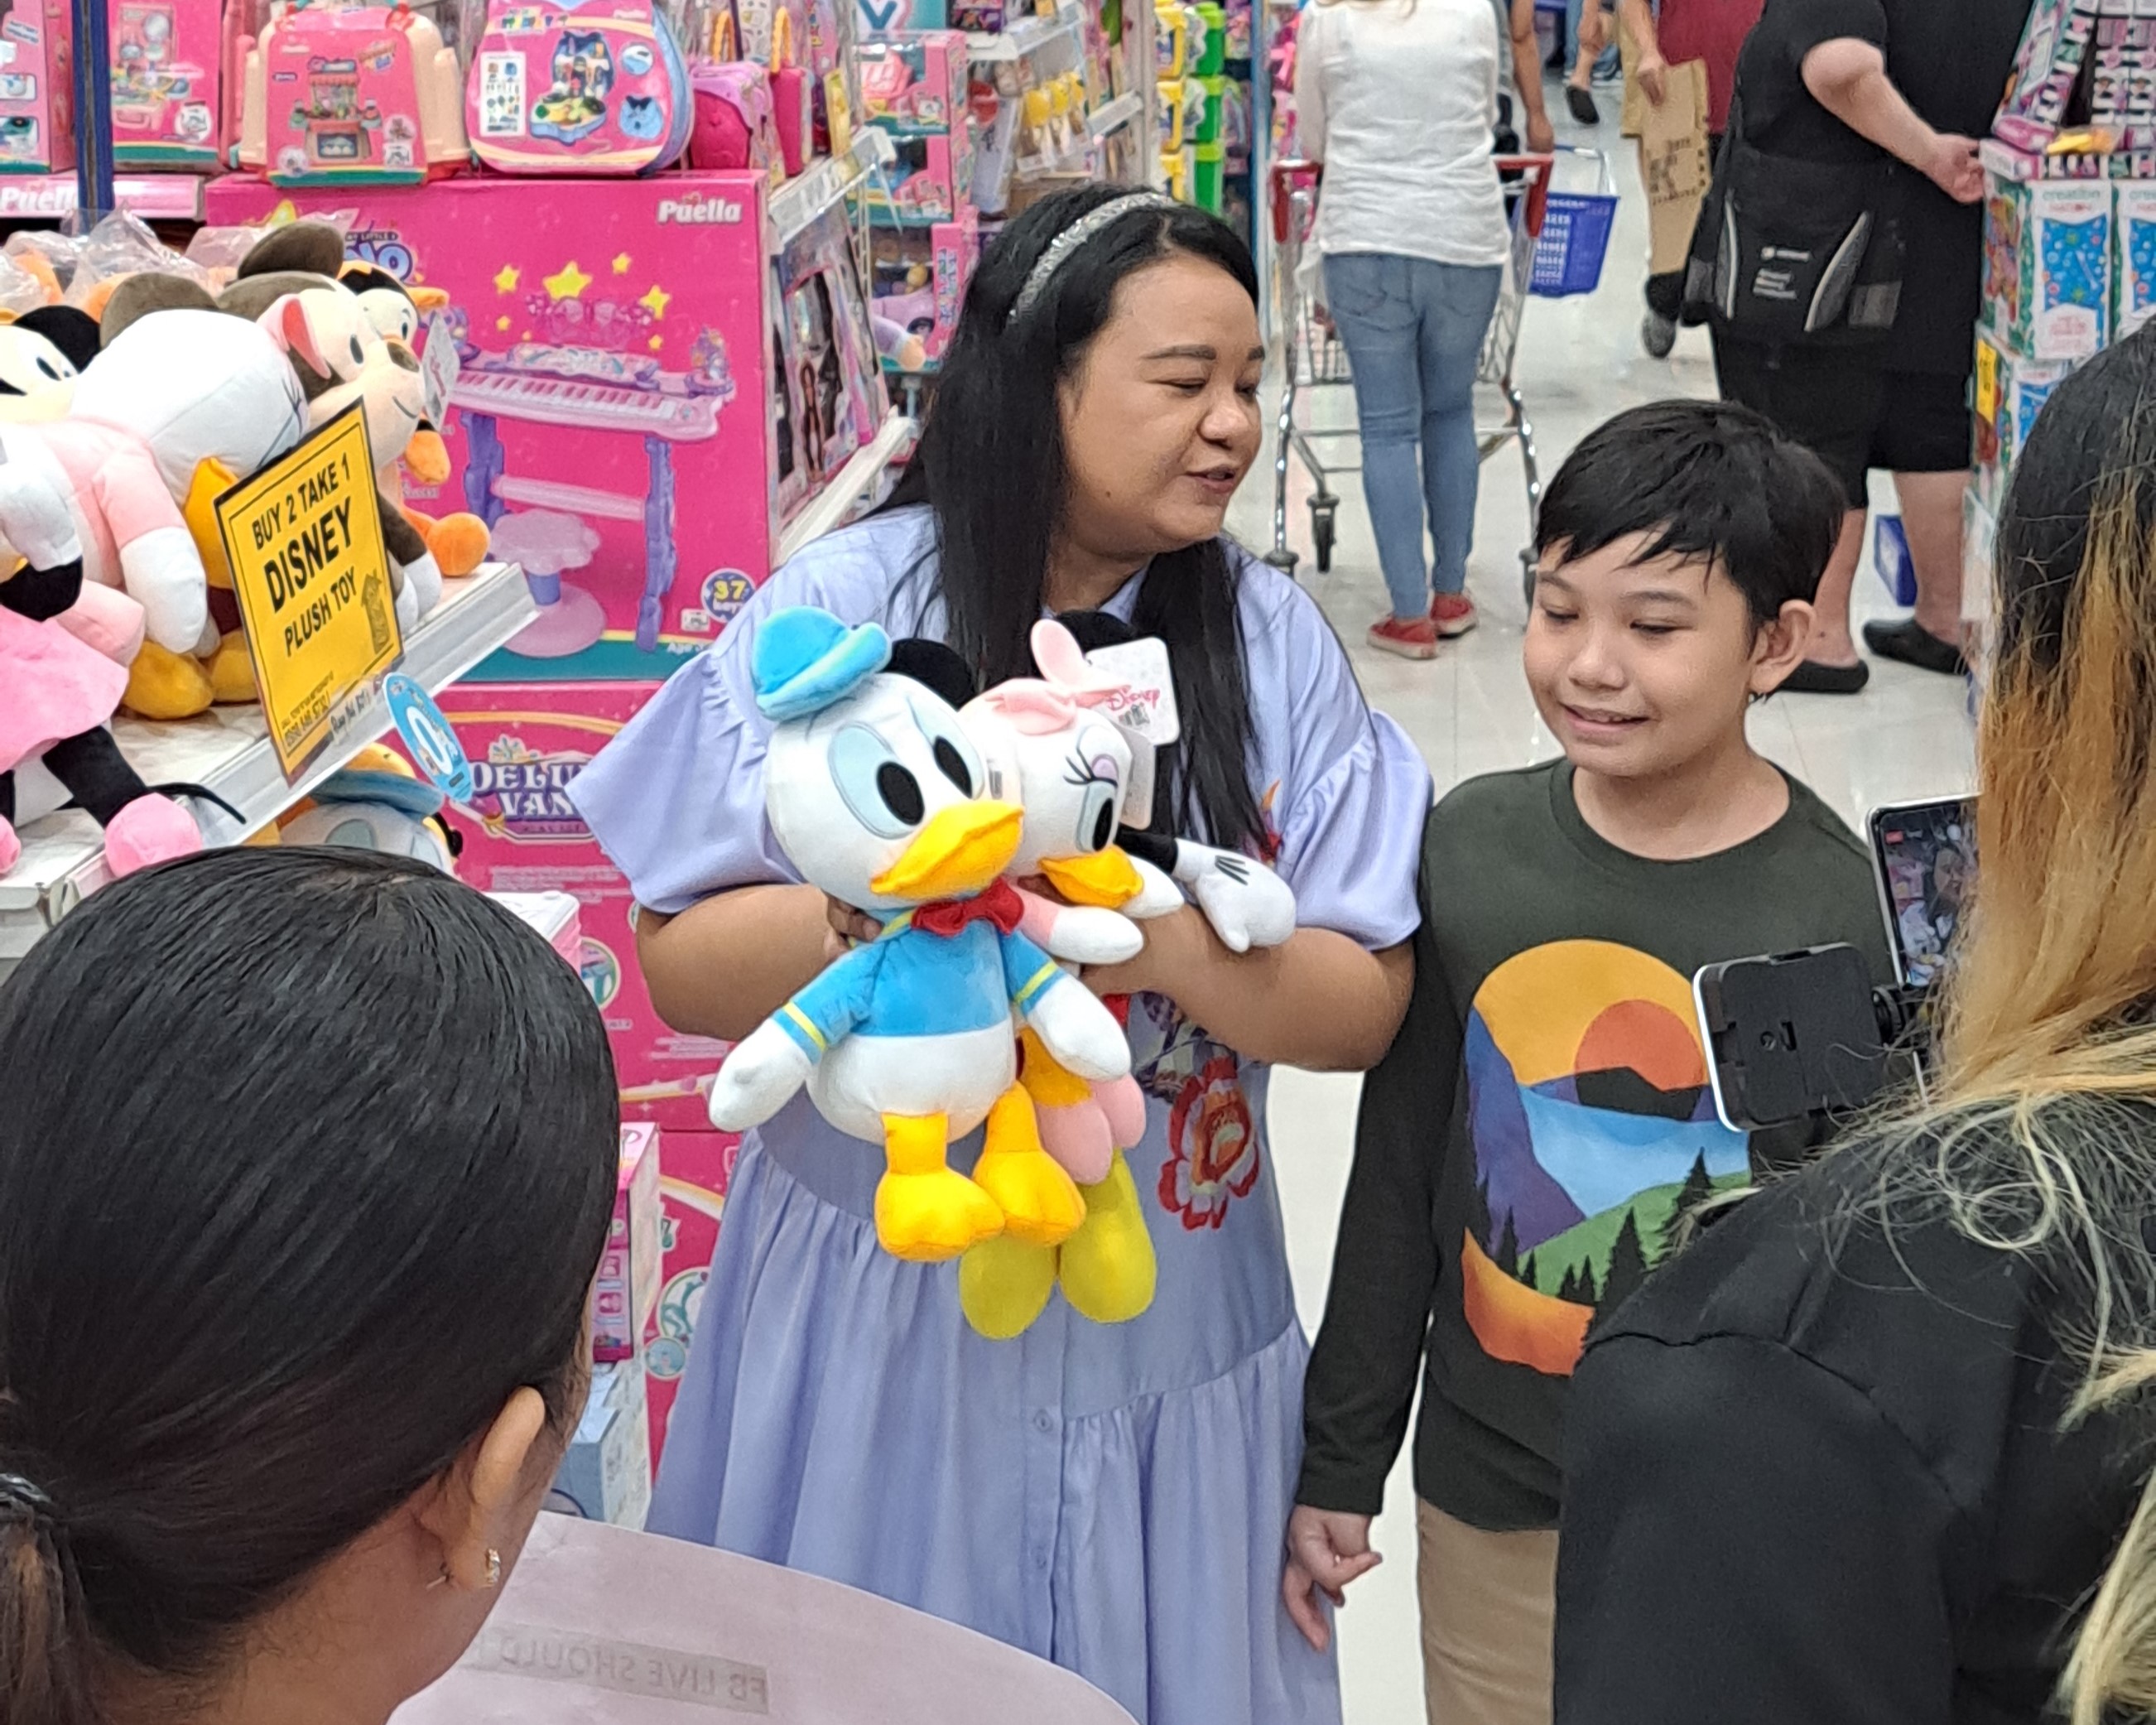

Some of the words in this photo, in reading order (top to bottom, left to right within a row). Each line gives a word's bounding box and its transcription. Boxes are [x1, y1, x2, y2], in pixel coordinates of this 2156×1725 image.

[2, 186, 79, 210] Puell
[657, 198, 743, 223] Puella
[252, 502, 282, 551] BUY
[286, 494, 297, 525] 2
[297, 460, 339, 513] TAKE
[341, 451, 350, 481] 1
[263, 496, 351, 614] DISNEY
[714, 580, 746, 600] 37
[284, 593, 332, 658] PLUSH
[330, 566, 357, 611] TOY
[469, 762, 581, 791] DELU
[498, 792, 575, 816] VAN
